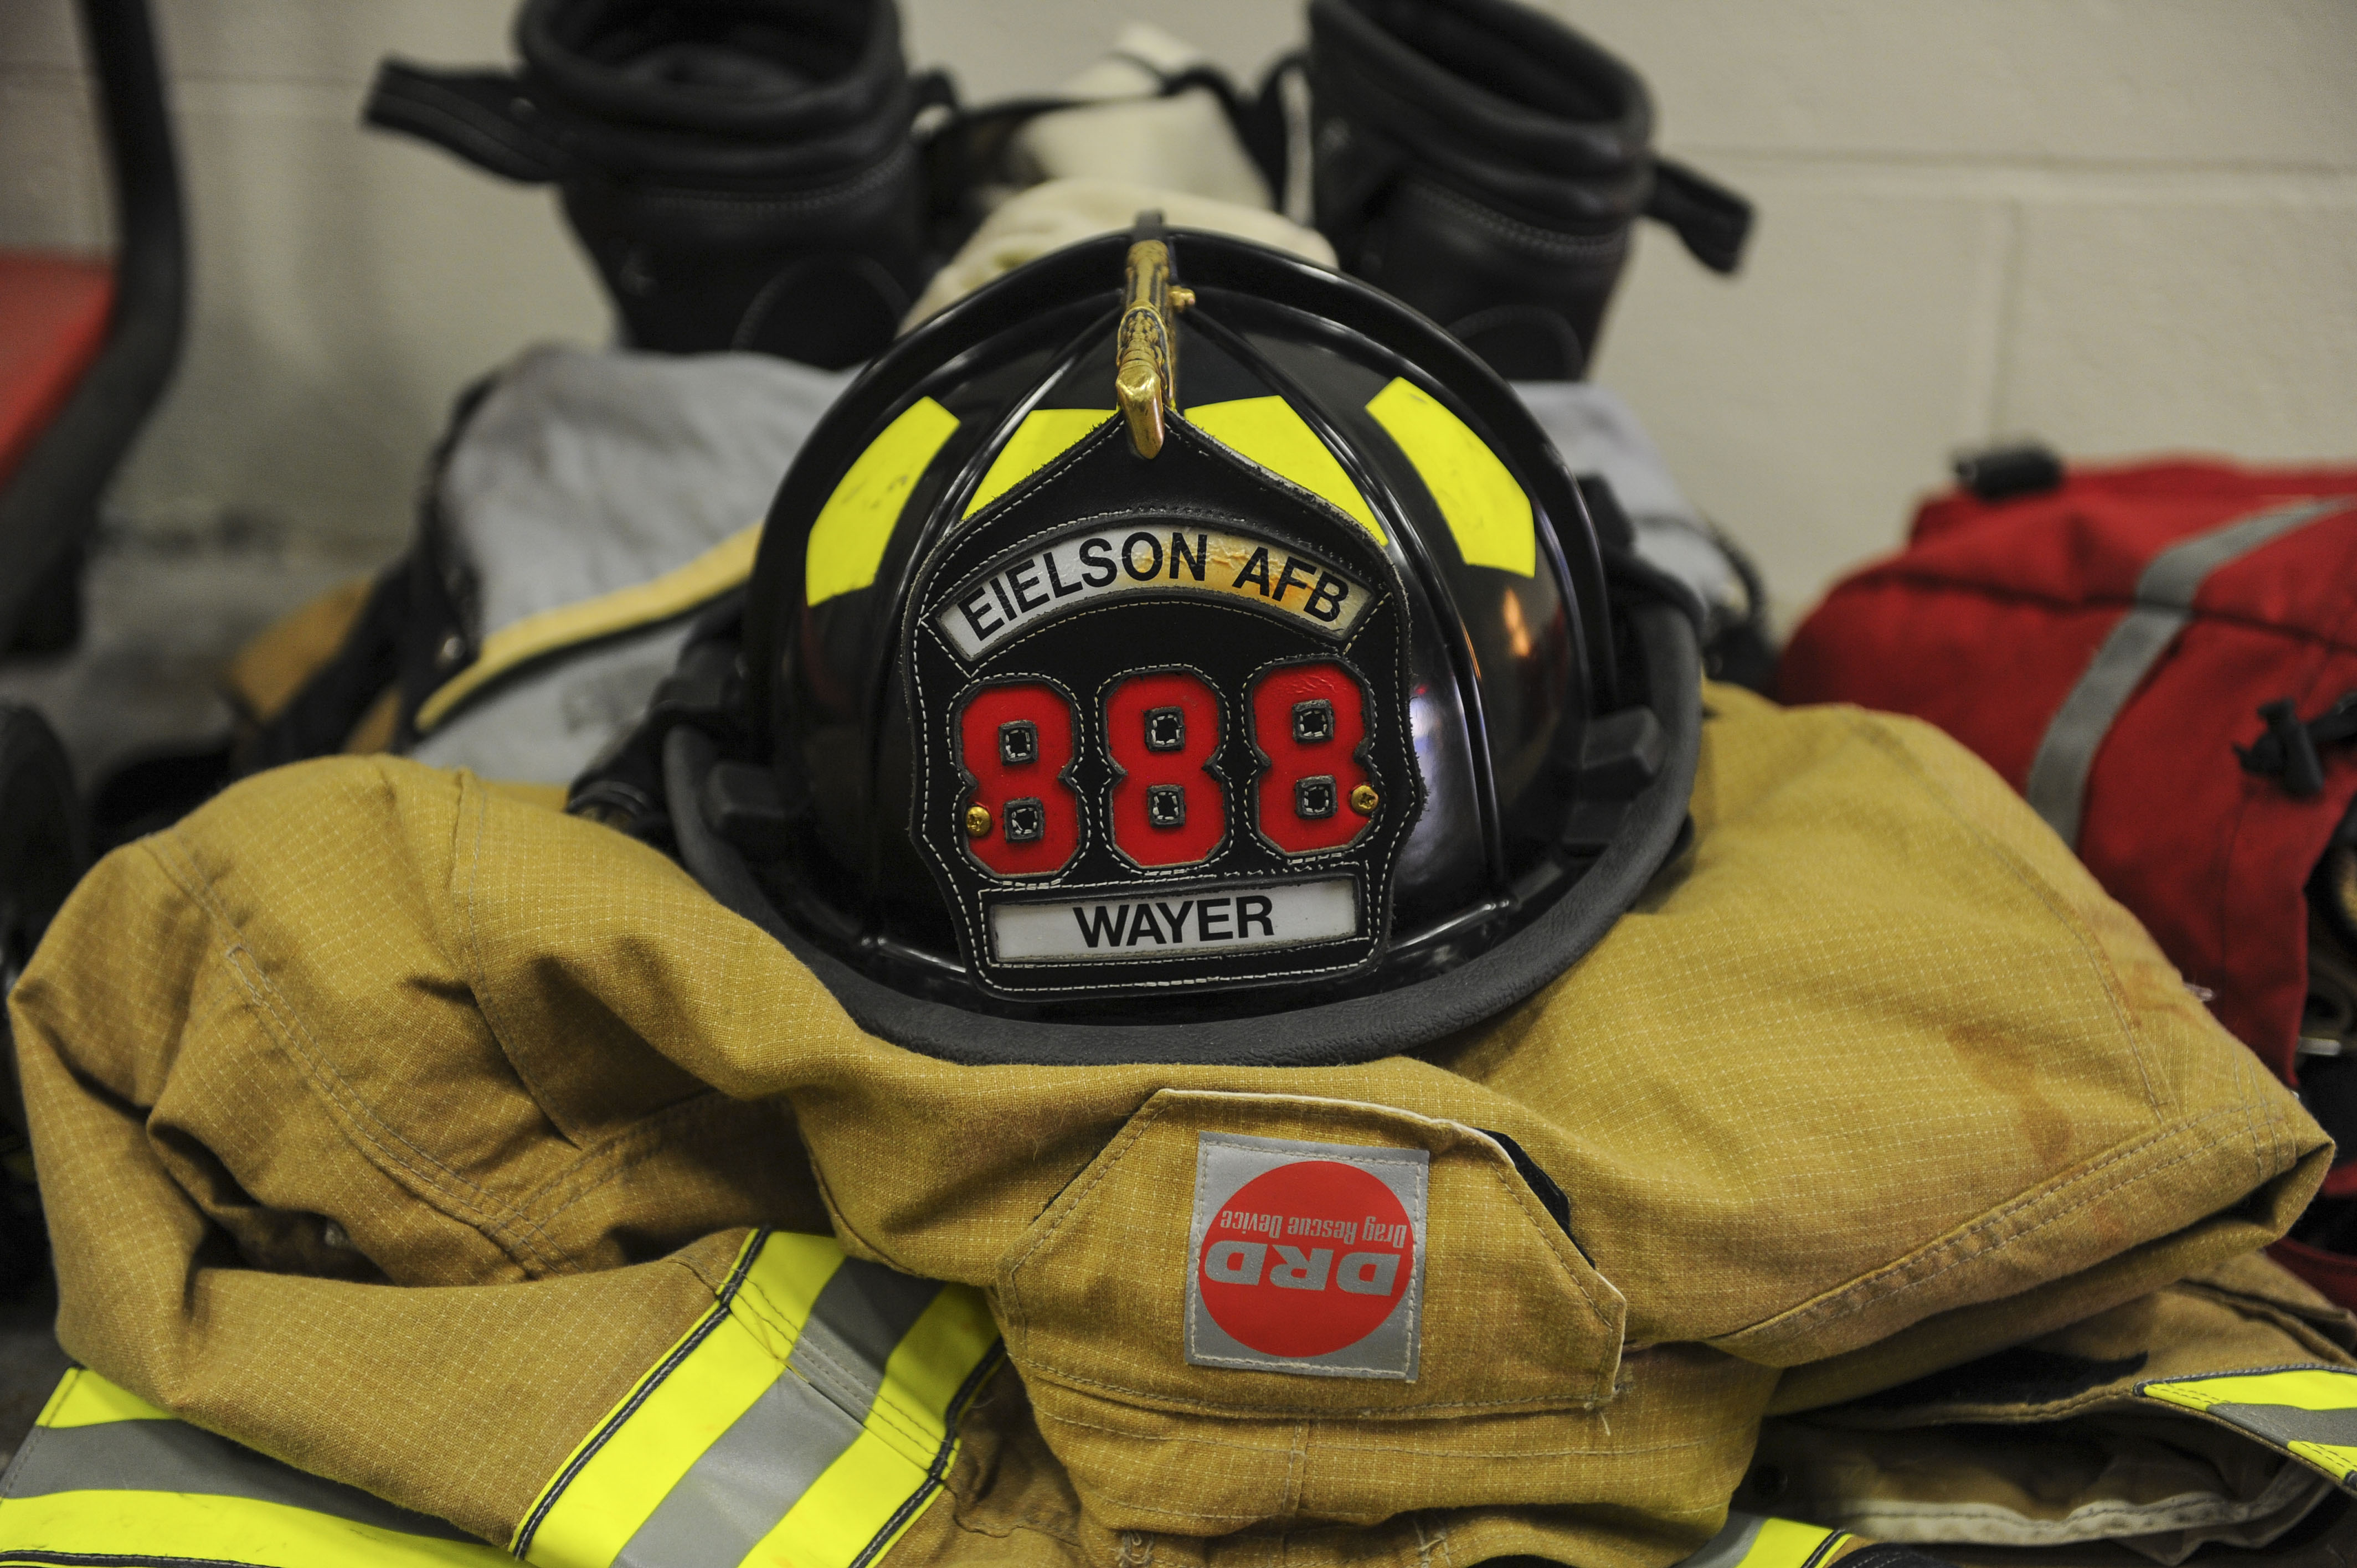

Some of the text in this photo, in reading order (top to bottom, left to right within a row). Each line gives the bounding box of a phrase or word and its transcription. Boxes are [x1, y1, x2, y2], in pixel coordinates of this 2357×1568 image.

[958, 532, 1350, 642] EIELSON AFB
[960, 664, 1376, 875] 888
[1073, 895, 1274, 947] WAYER
[1221, 1211, 1407, 1249] Drag Rescue Device
[1205, 1241, 1401, 1296] DRD
